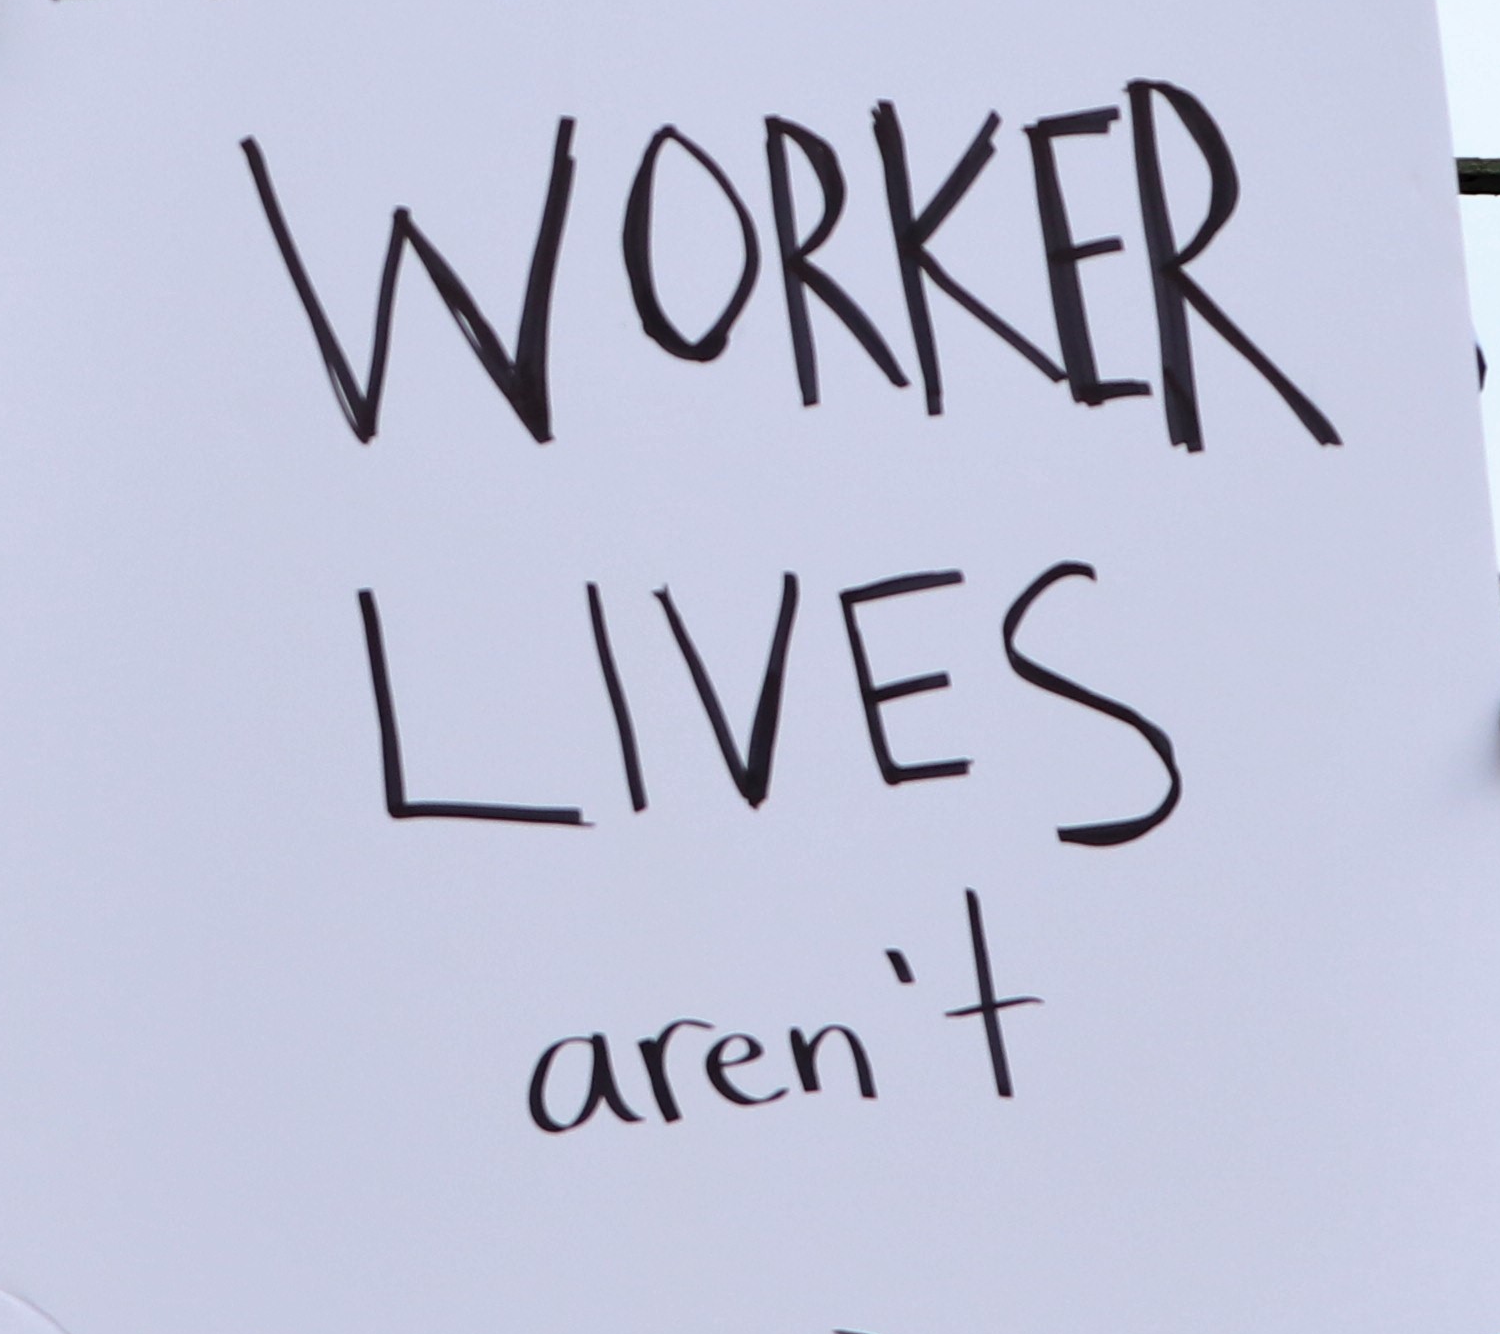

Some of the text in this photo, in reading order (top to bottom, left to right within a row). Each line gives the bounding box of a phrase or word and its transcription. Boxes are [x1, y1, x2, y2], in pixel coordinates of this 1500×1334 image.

[241, 80, 1341, 453] WORKER
[358, 562, 1181, 846] LIVES
[529, 890, 1039, 1133] aren't
